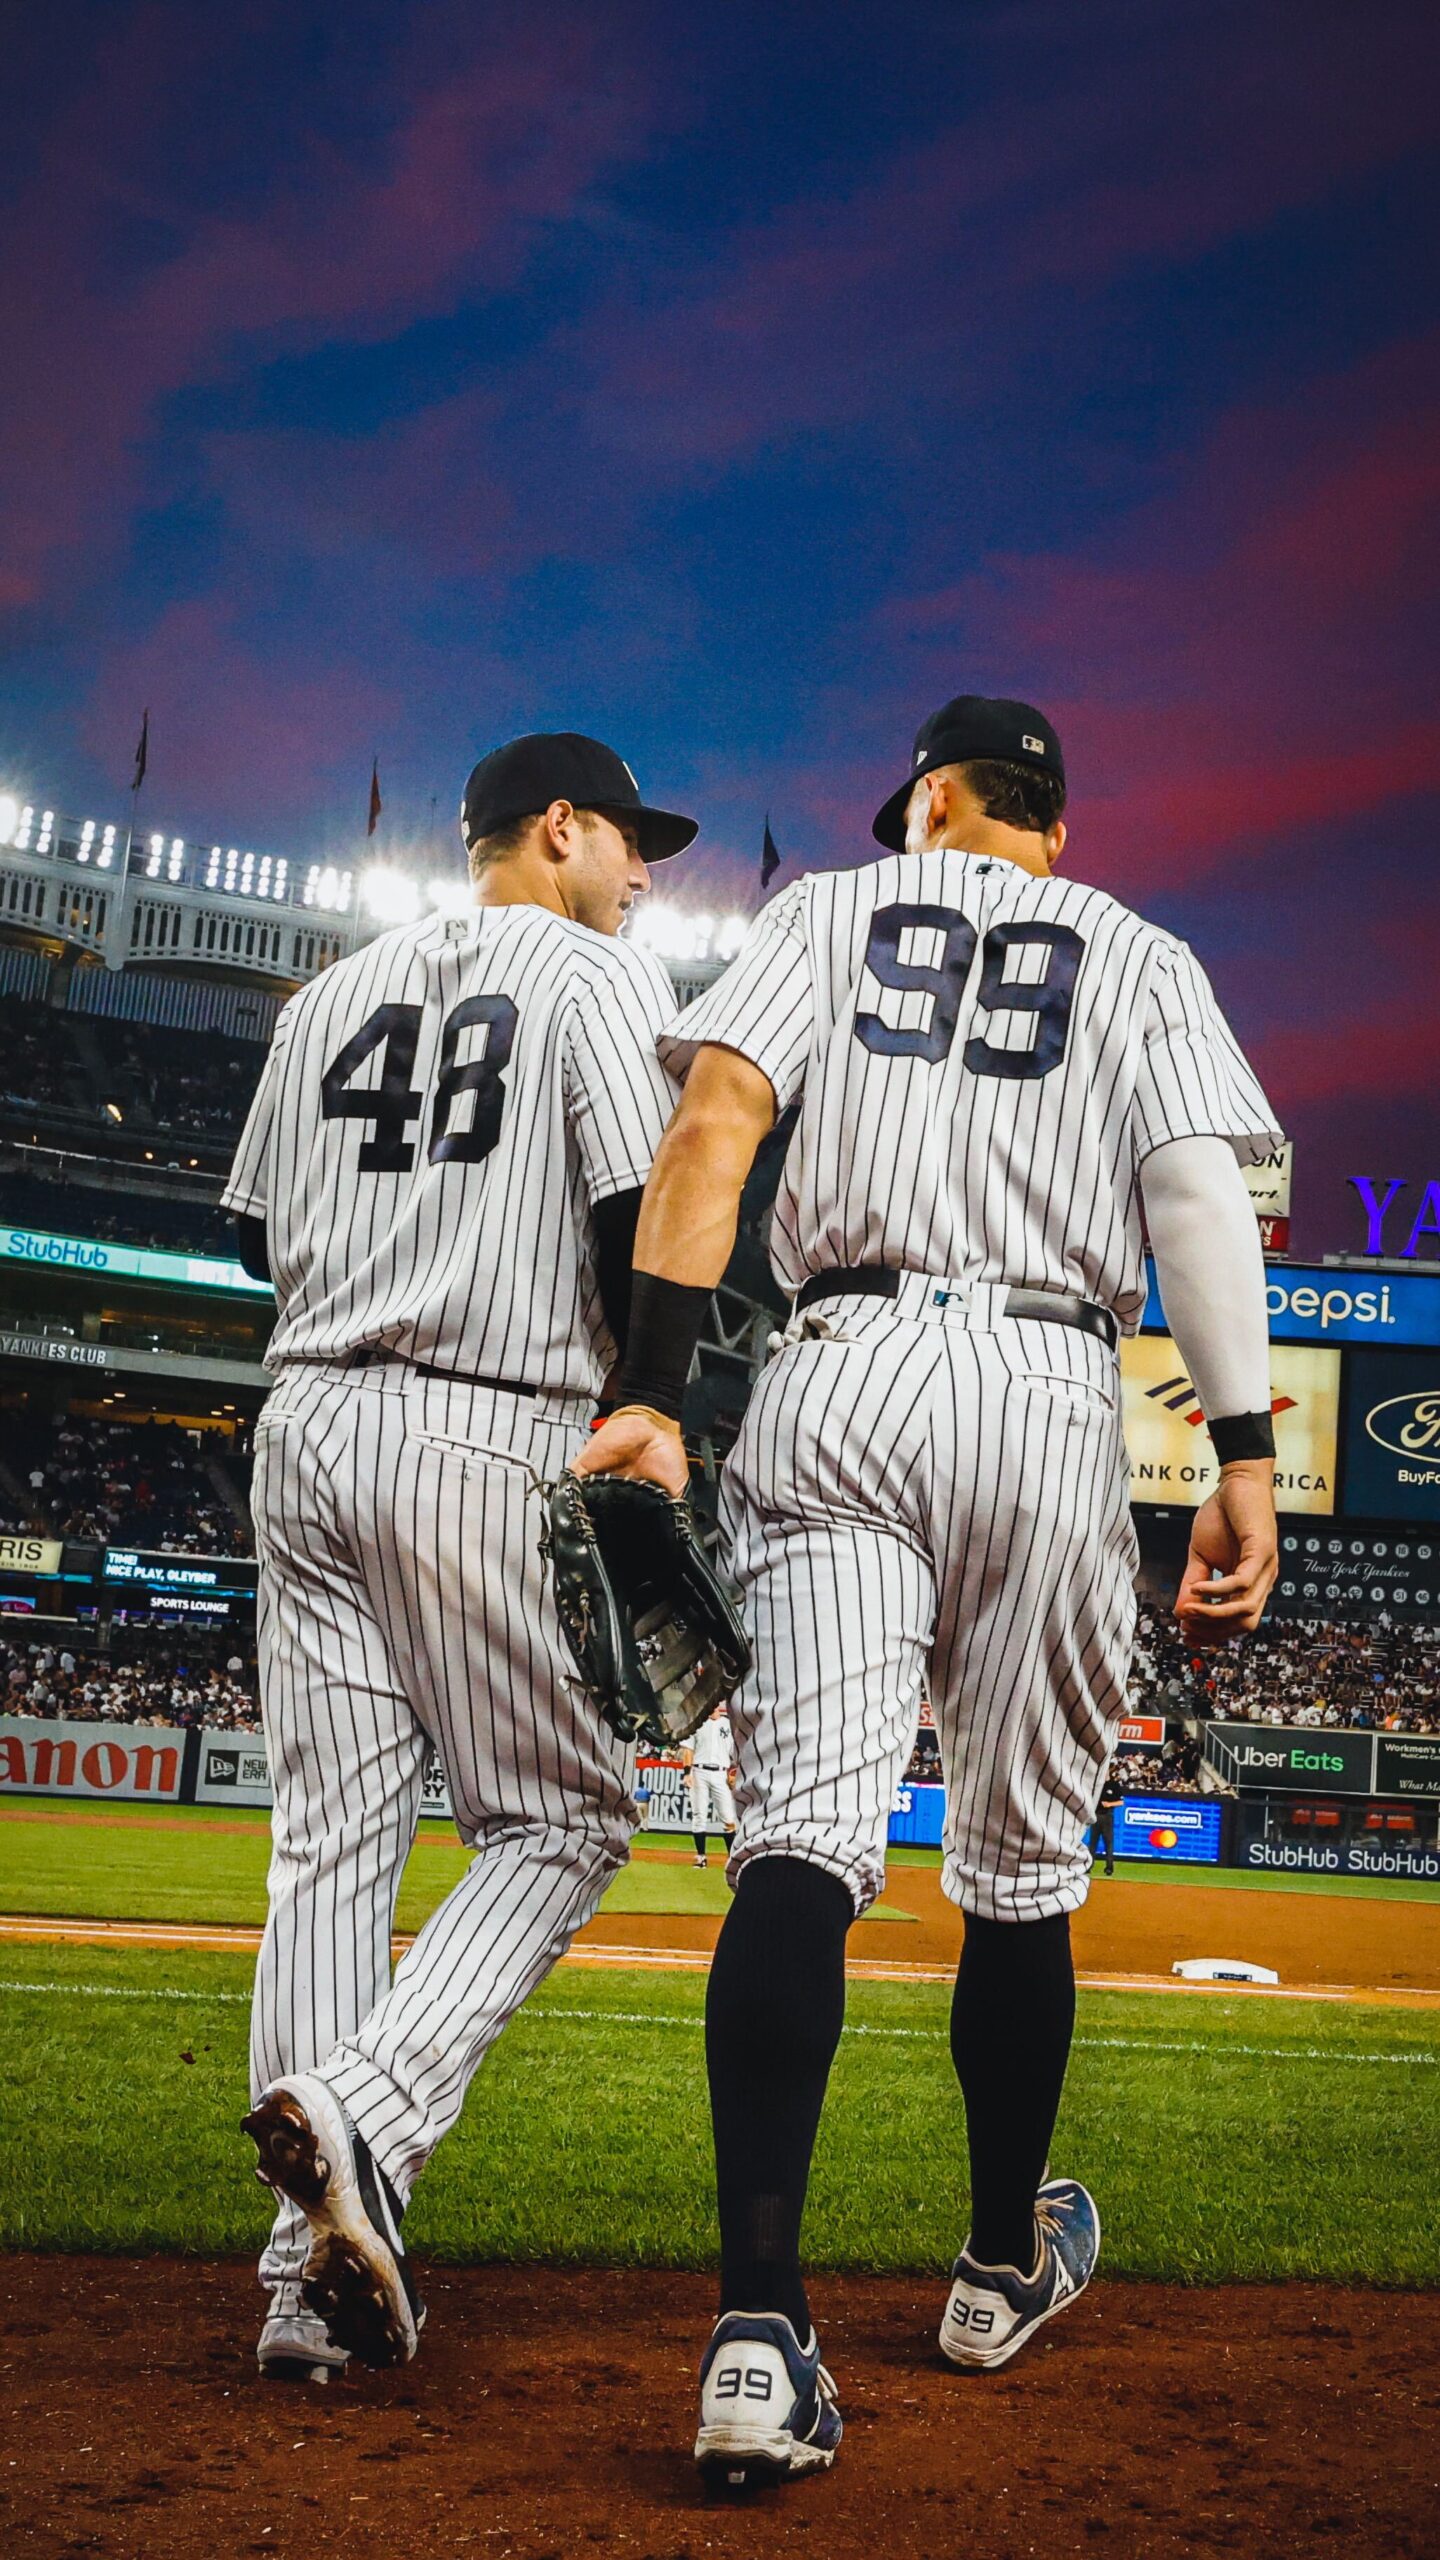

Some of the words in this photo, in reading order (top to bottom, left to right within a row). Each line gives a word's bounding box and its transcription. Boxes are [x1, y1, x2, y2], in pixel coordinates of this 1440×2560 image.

[854, 902, 1086, 1080] 99
[321, 994, 519, 1172] 48
[8, 1232, 108, 1268] StubHub
[2, 1336, 67, 1359] YANKEES
[70, 1346, 106, 1364] CLUB
[1180, 1467, 1210, 1483] OF
[105, 1564, 132, 1576] NICE
[1303, 1558, 1329, 1573] New
[1331, 1560, 1360, 1579] York
[1361, 1562, 1410, 1582] Yankees
[150, 1597, 189, 1609] SPORTS
[190, 1600, 230, 1614] LOUNGE
[1233, 1745, 1287, 1768] Uber
[1290, 1749, 1344, 1772] Eats
[1384, 1743, 1437, 1754] Workmen's
[242, 1769, 266, 1780] ERA
[243, 1758, 268, 1770] NEW
[1128, 1811, 1198, 1825] yankees.com
[1248, 1843, 1339, 1868] StubHub
[1347, 1849, 1439, 1876] StubHub
[949, 2298, 995, 2334] 99
[715, 2368, 773, 2402] 99
